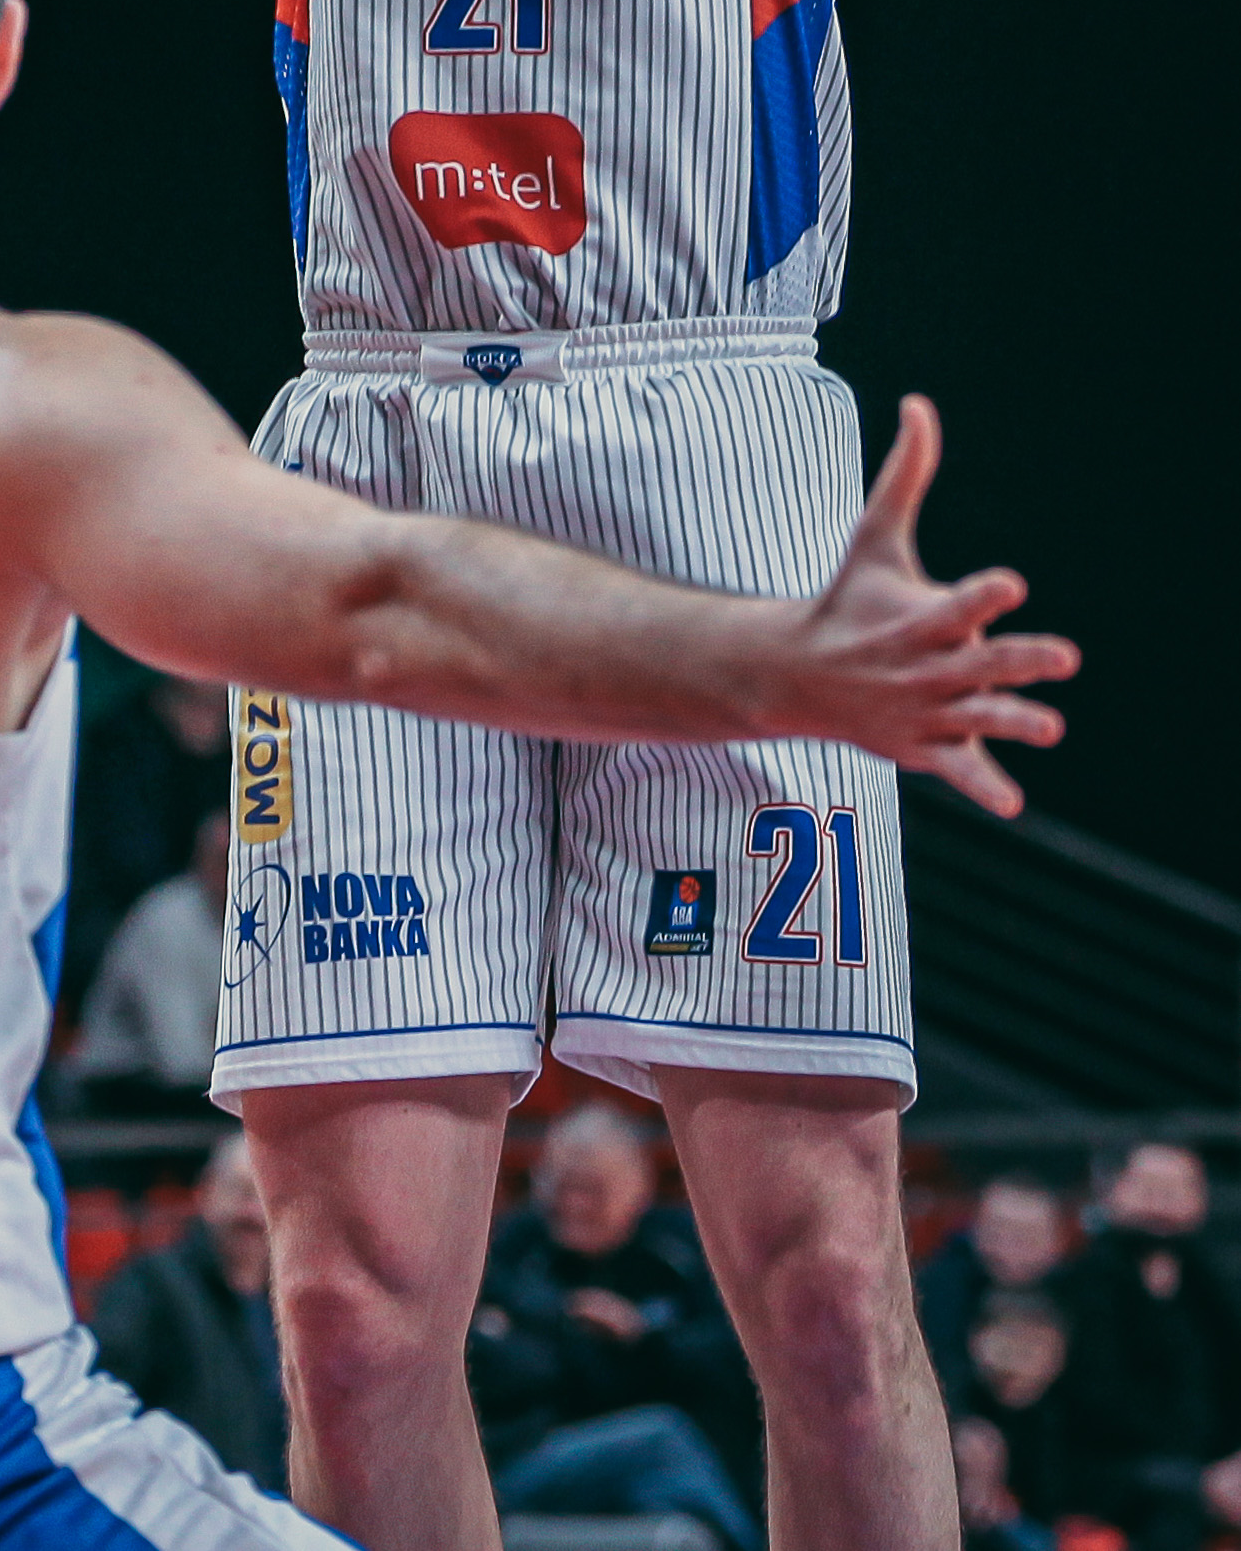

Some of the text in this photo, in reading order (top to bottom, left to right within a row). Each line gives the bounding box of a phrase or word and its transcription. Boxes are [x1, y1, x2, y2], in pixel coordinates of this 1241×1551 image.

[415, 155, 561, 210] m:tel
[244, 689, 280, 824] MOZ
[302, 872, 423, 921] NOVA
[742, 803, 867, 968] 21
[304, 919, 430, 964] BANKA
[671, 905, 693, 926] ABA
